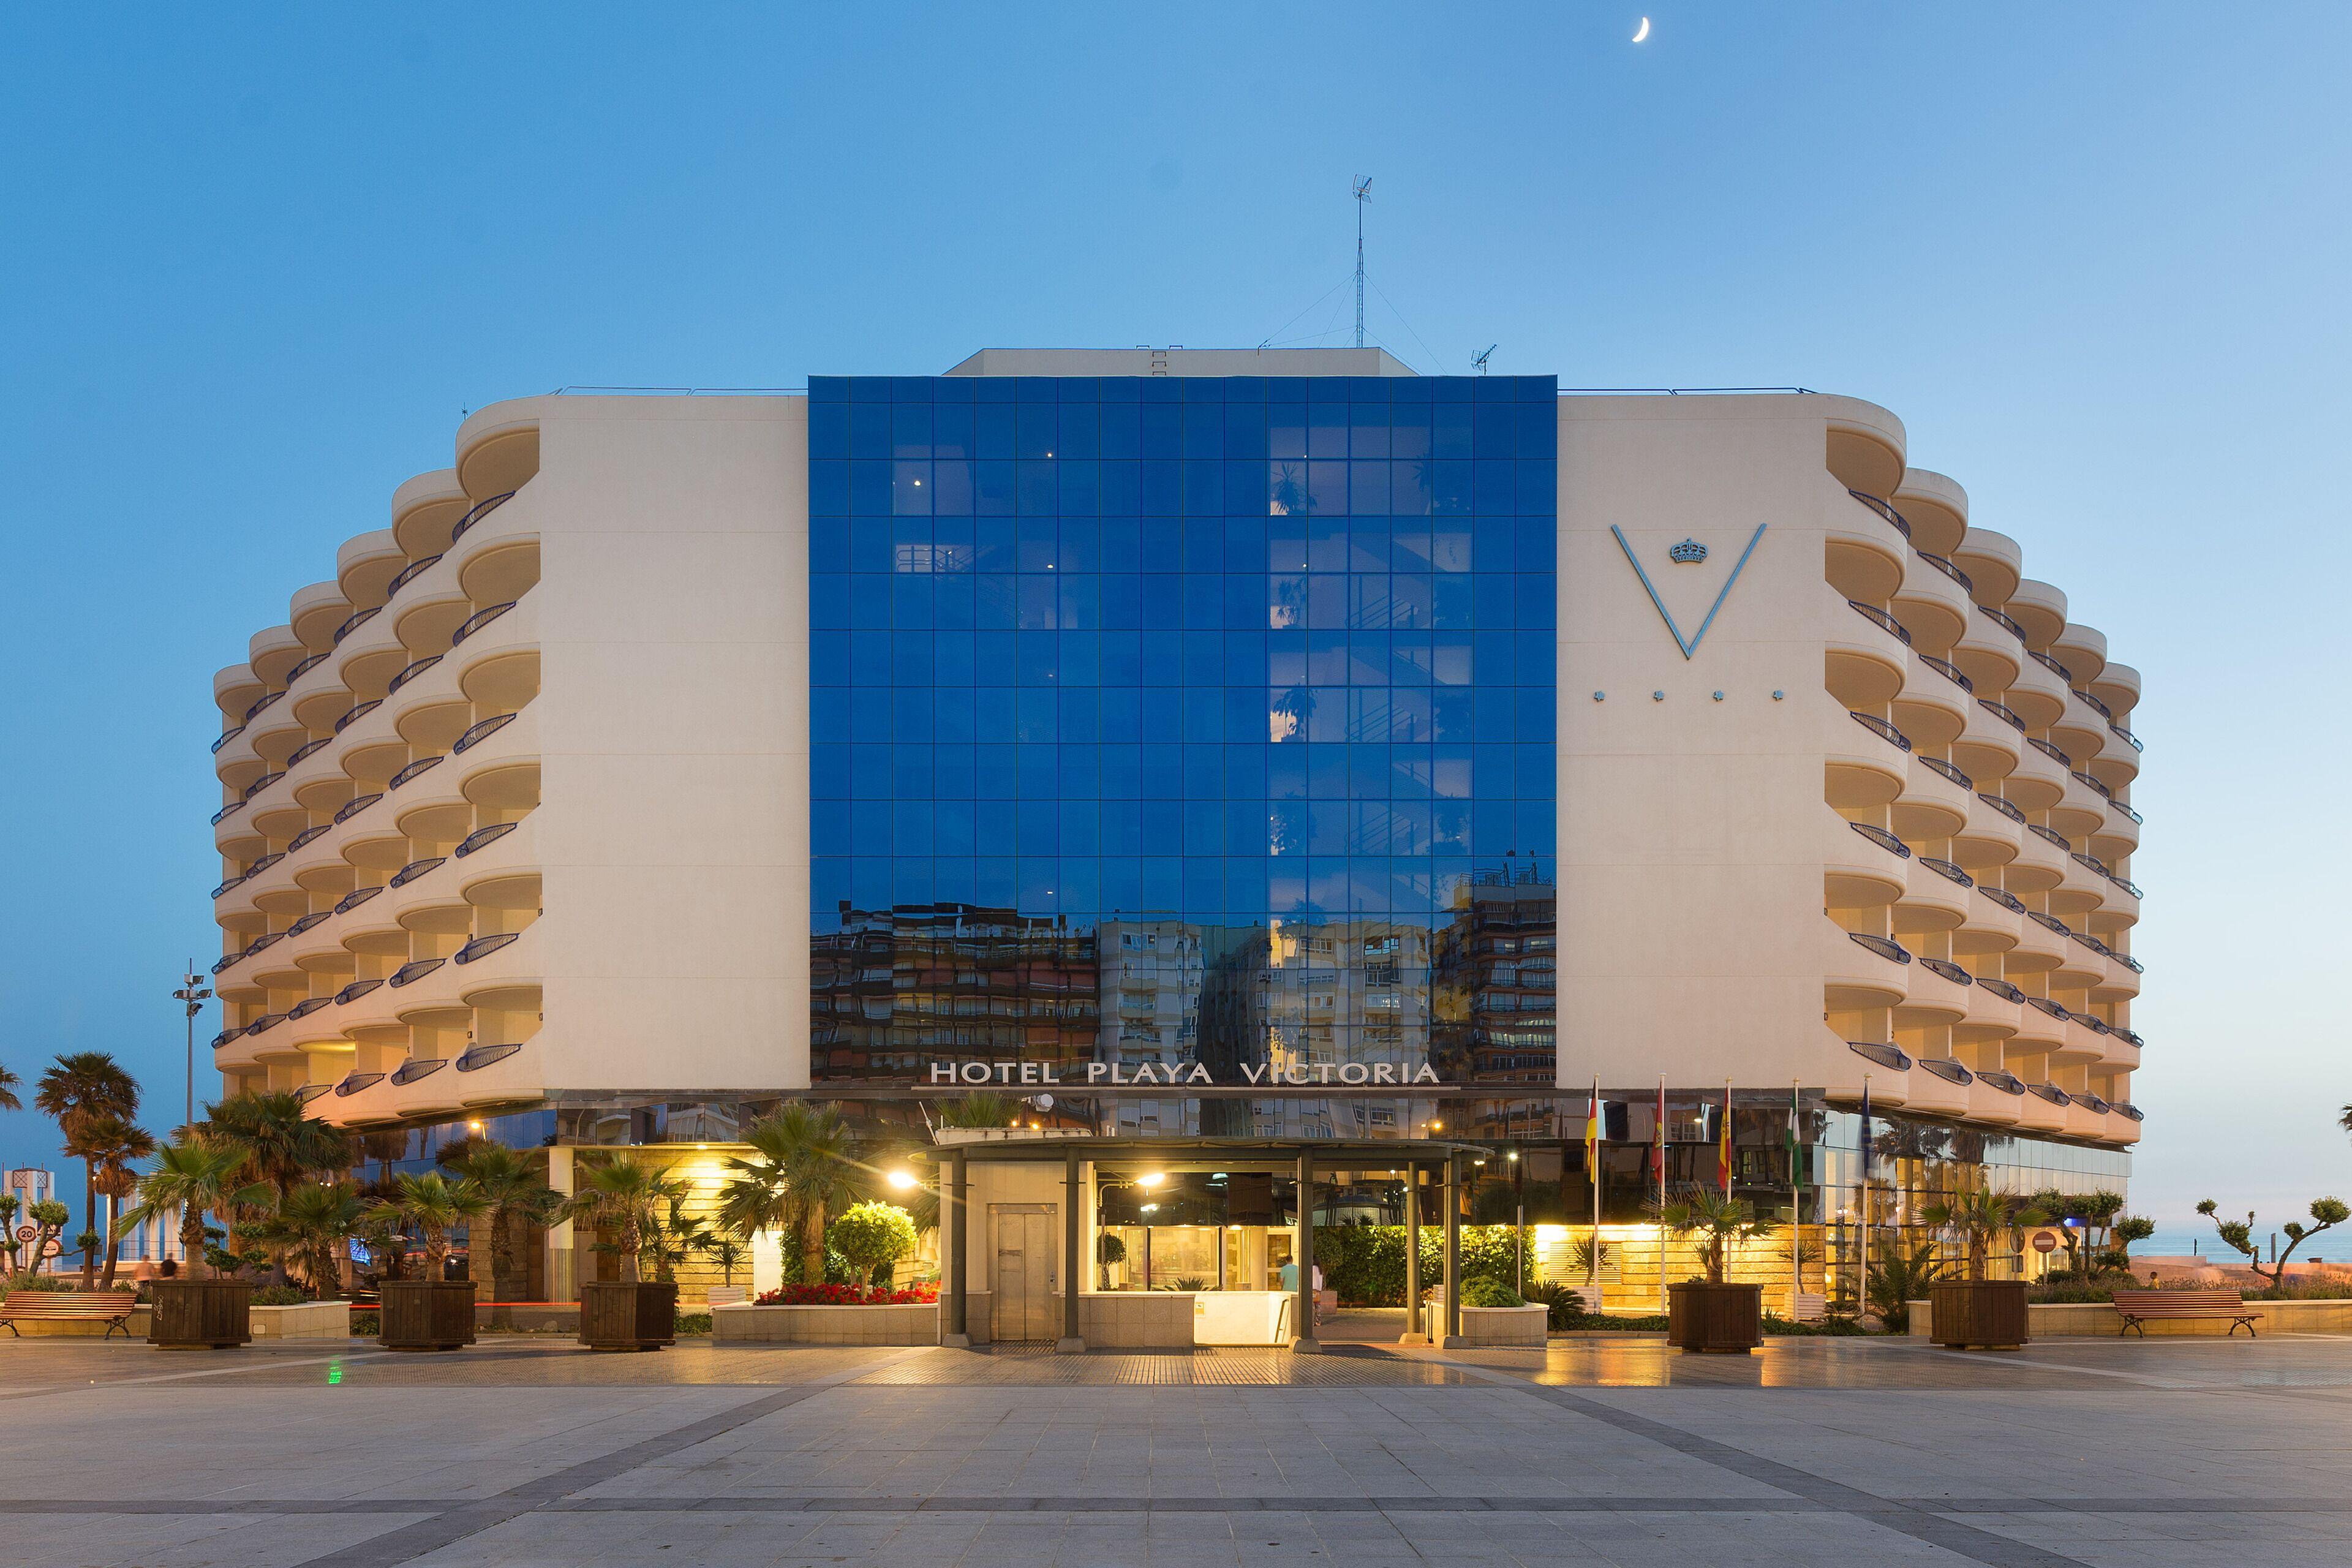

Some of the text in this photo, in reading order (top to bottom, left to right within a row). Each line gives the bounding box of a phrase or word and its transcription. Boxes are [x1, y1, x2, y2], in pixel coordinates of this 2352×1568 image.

[931, 1062, 1440, 1084] HOTEL PLAYA VICTORIA
